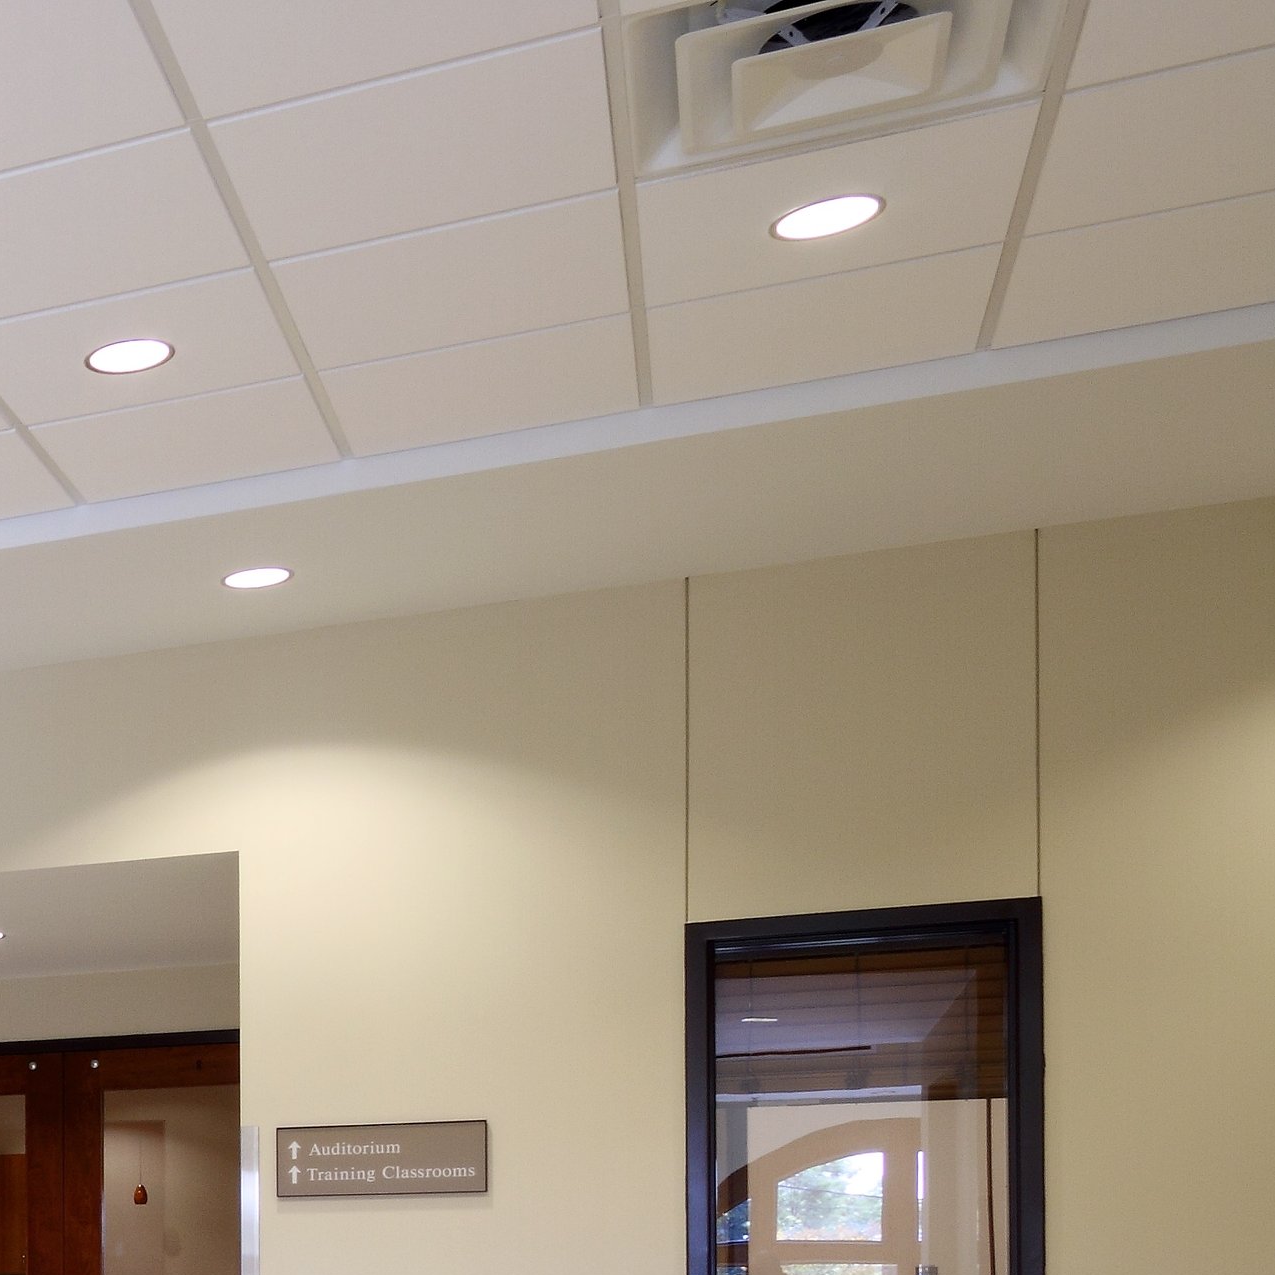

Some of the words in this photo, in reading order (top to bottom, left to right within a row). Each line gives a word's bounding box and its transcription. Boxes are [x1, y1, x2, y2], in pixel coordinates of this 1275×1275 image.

[308, 1141, 401, 1157] Auditorium
[306, 1166, 376, 1183] Training
[382, 1164, 476, 1180] Classrooms
